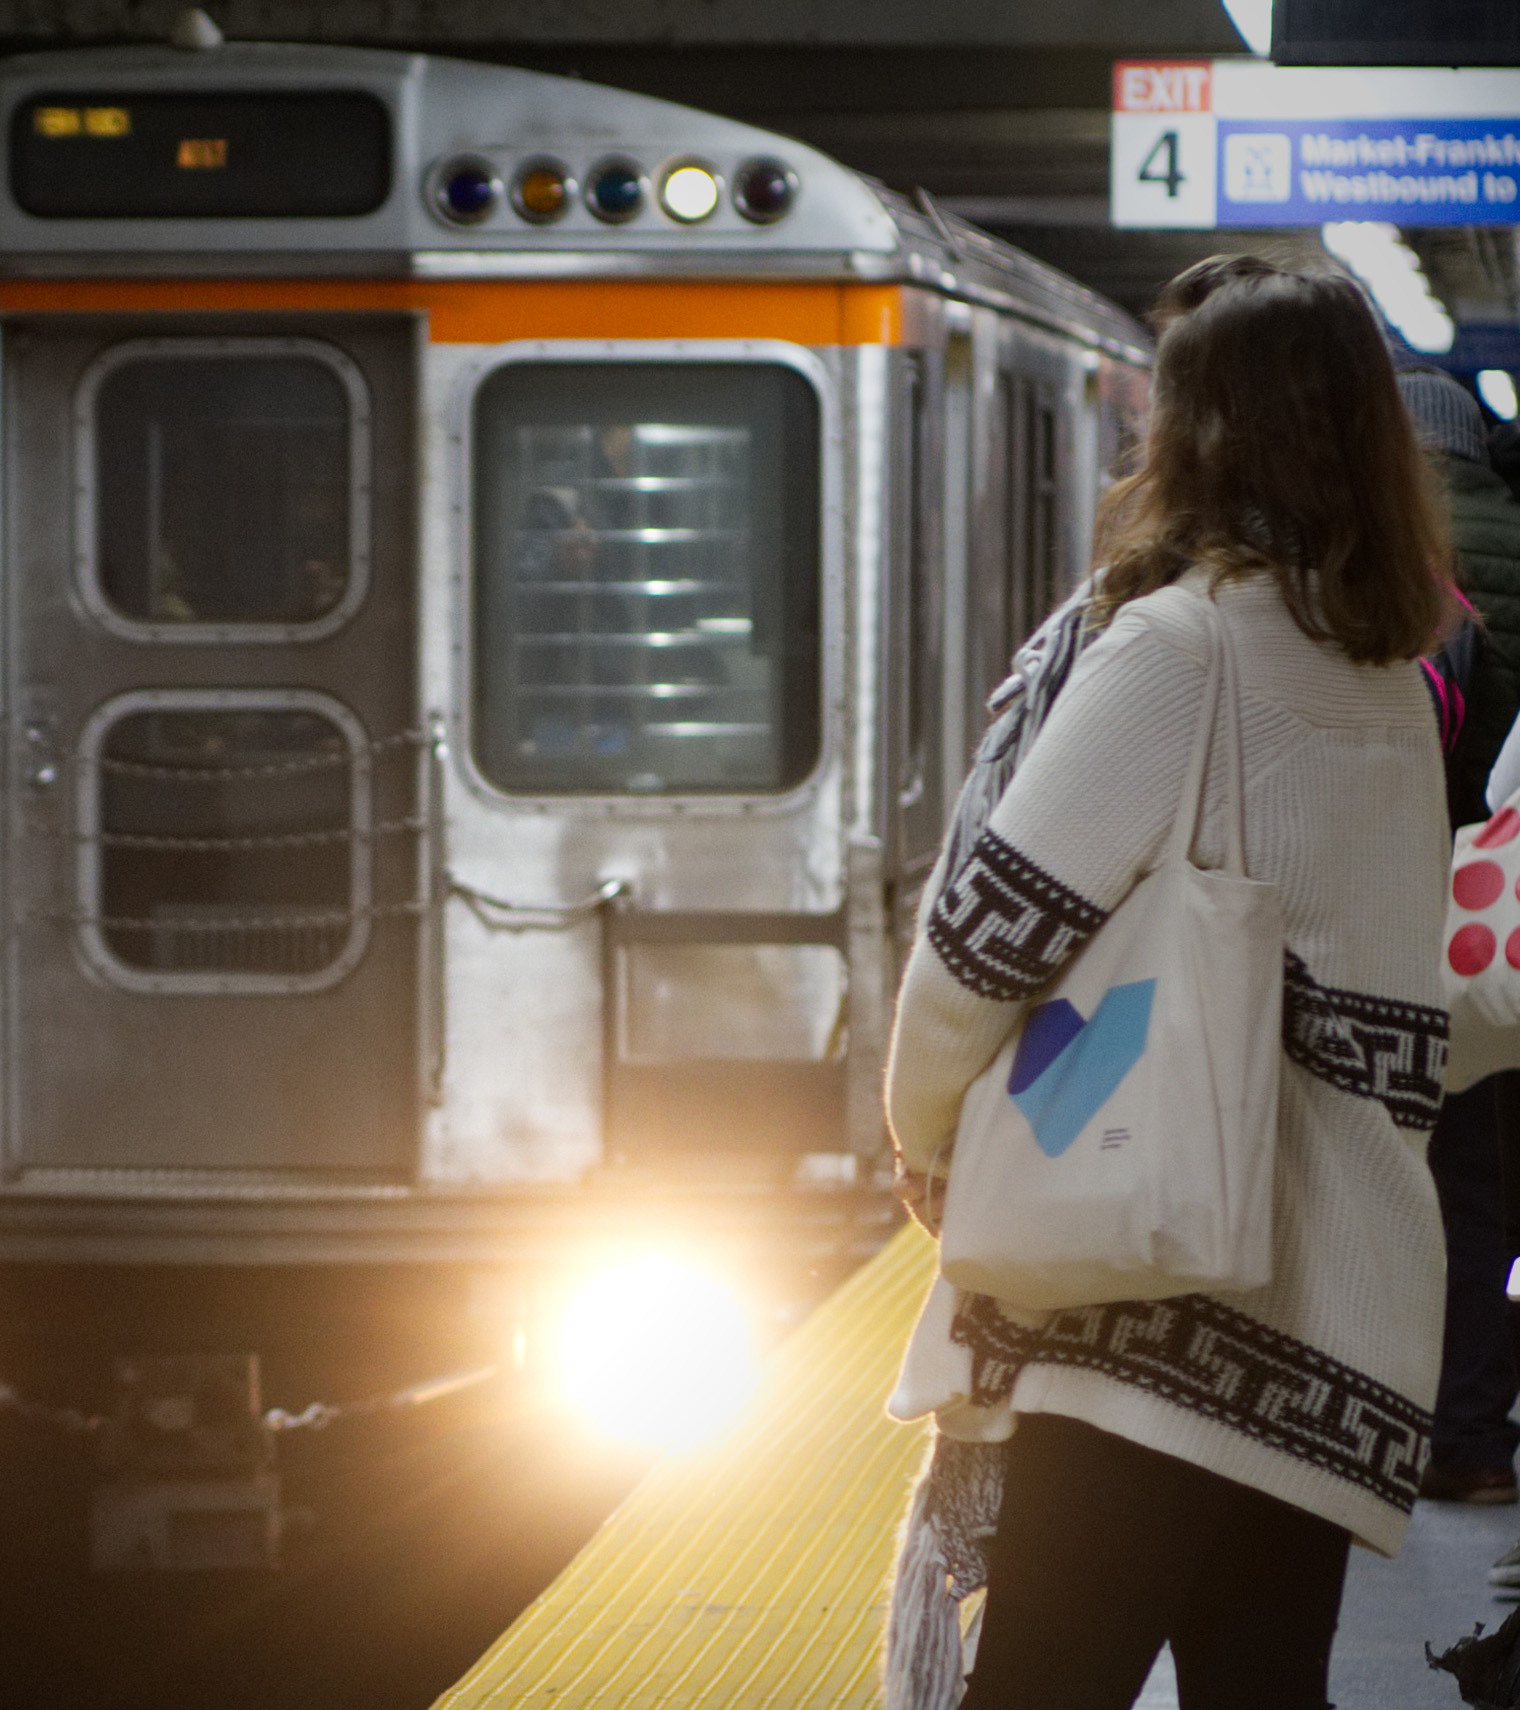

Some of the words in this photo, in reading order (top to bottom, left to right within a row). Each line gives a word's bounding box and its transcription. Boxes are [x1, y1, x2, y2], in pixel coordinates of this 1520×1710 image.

[1121, 66, 1209, 112] EXIT
[1137, 129, 1186, 199] 4
[1300, 169, 1479, 203] Westbound
[1483, 171, 1518, 203] to
